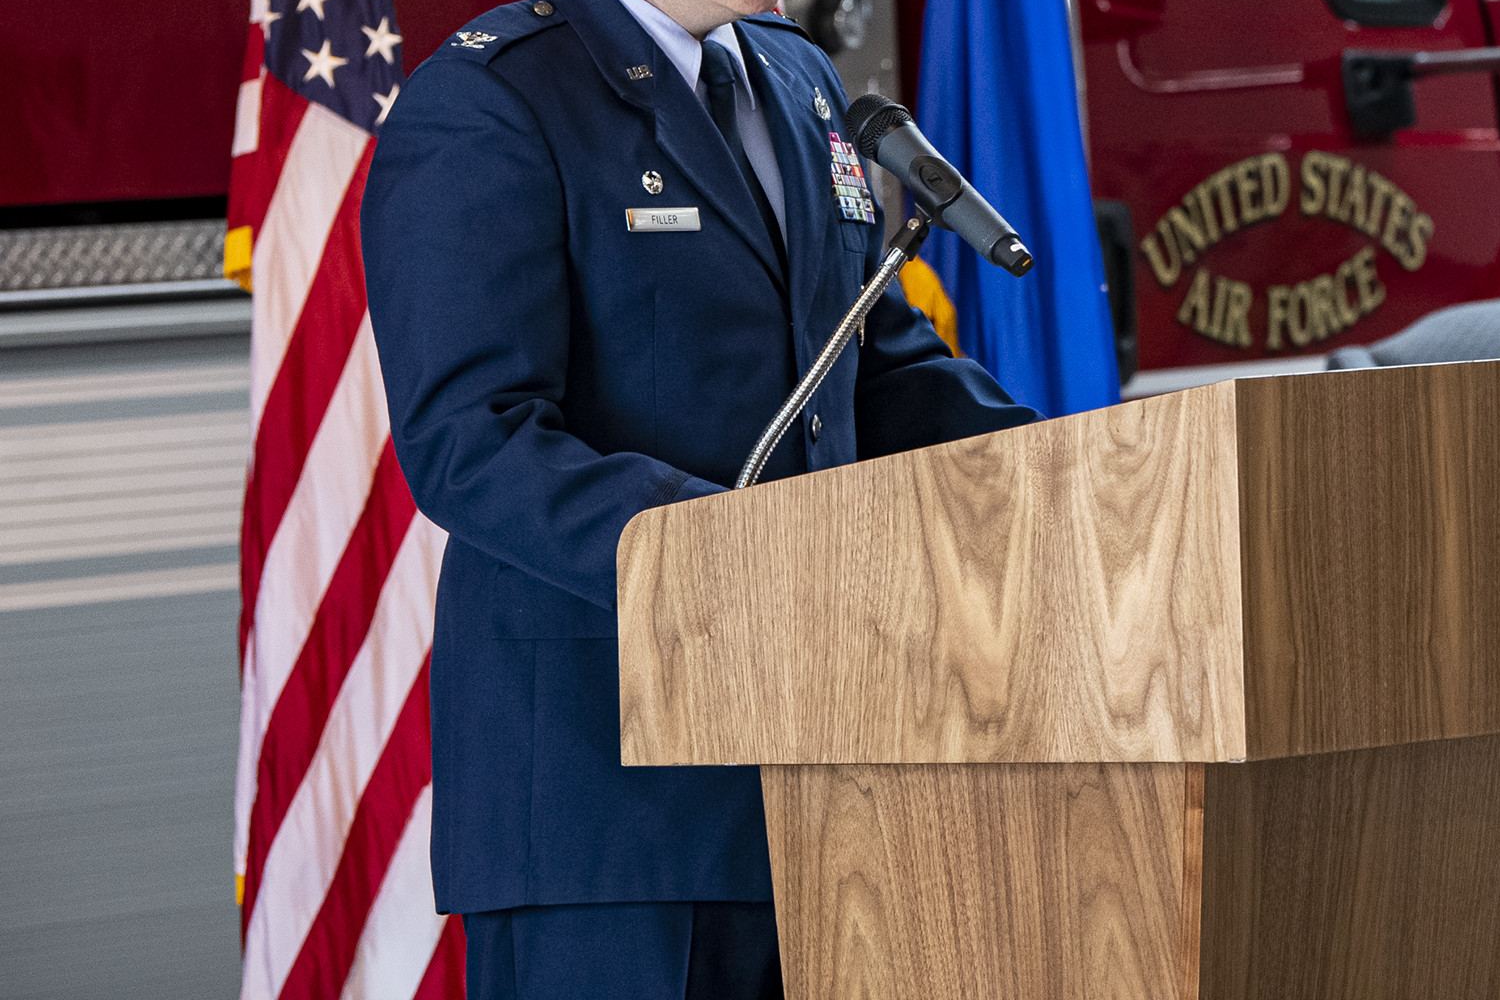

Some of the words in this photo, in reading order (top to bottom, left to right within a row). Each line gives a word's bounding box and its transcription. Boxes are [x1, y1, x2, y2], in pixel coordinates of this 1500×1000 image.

[651, 214, 679, 225] FILLER
[1142, 152, 1290, 287] UNITED
[1301, 150, 1434, 272] STATES
[1177, 268, 1252, 348] AIR
[1266, 247, 1386, 350] FORCE
